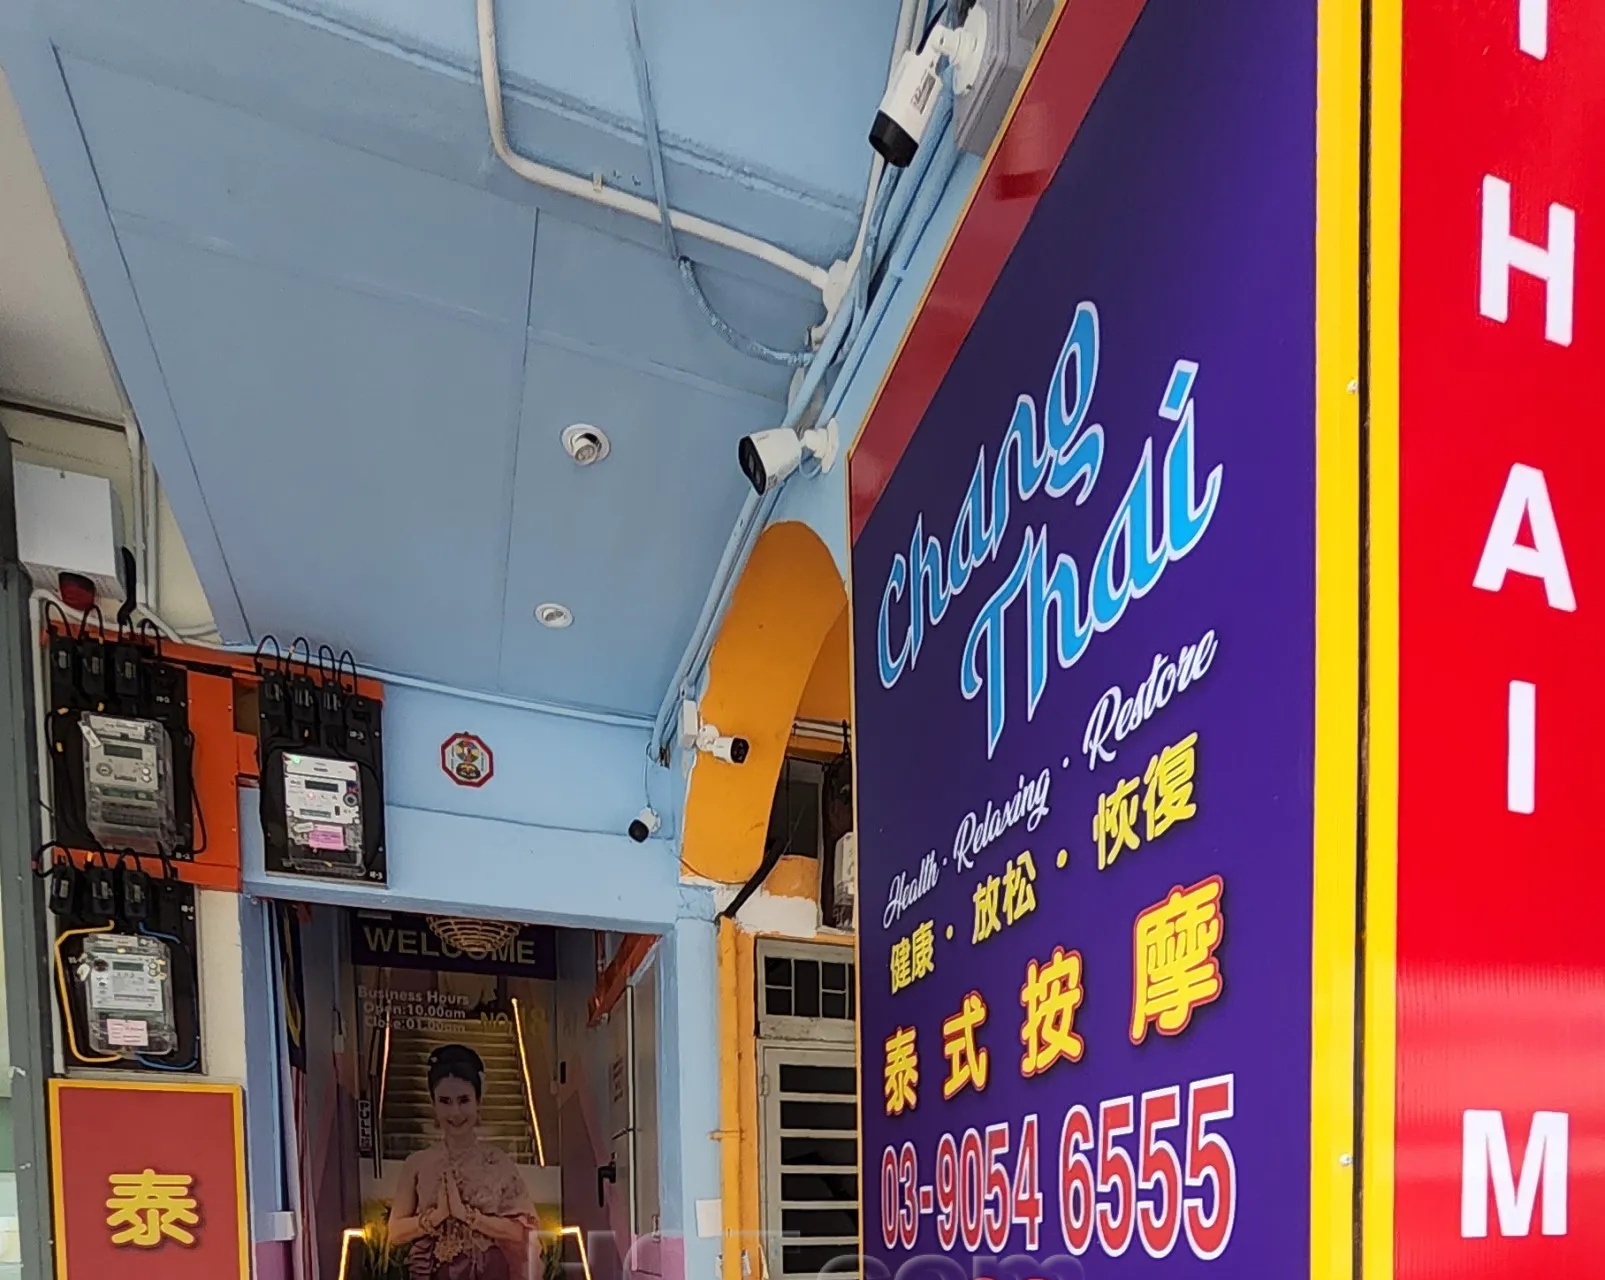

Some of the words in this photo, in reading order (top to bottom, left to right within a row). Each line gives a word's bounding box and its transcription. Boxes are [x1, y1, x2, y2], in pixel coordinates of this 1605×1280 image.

[876, 300, 1106, 690] Chang
[960, 359, 1224, 761] Thai
[883, 850, 940, 929] Health
[952, 767, 1051, 873] Relaxing
[1081, 628, 1218, 771] Restore
[889, 920, 935, 995] 健康
[970, 849, 1037, 945] 放松
[1092, 732, 1199, 871] 恢復
[357, 984, 422, 1002] Business
[426, 989, 469, 1005] Hours
[884, 874, 1224, 1116] 泰式按摩
[881, 1113, 1043, 1253] 03-9054
[1059, 1072, 1237, 1261] 6555
